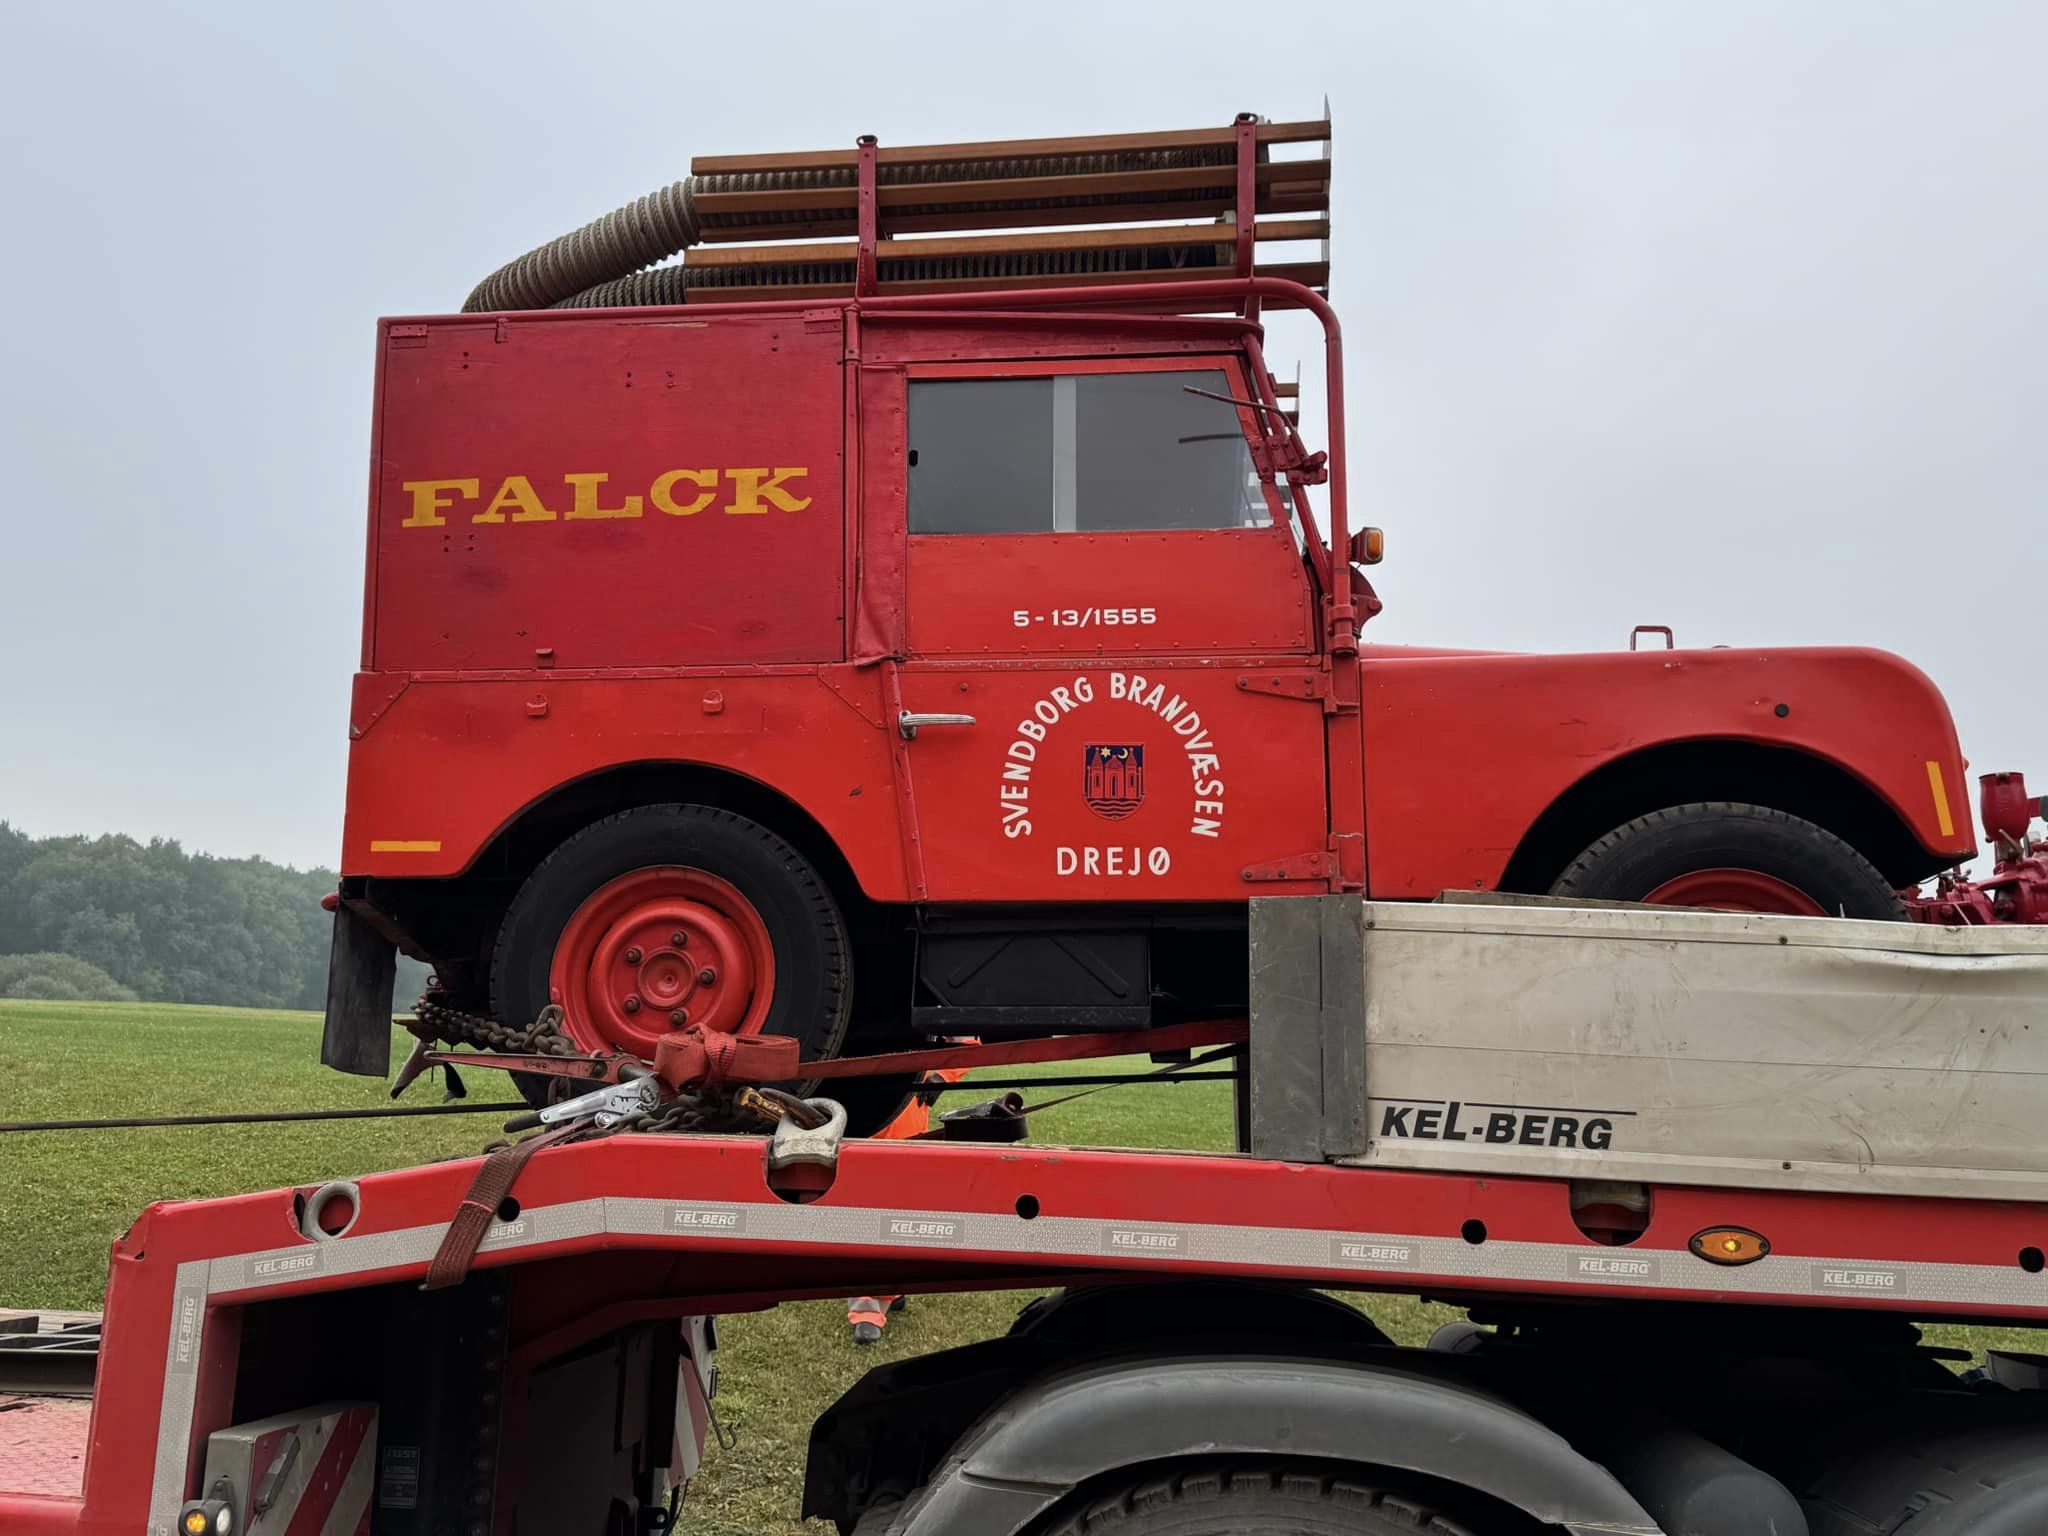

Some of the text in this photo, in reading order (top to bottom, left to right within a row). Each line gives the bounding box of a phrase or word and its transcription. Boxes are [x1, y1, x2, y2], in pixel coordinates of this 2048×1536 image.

[402, 467, 812, 528] FALCK
[1000, 672, 1224, 838] SVENDBORG BRANDVÆSEN
[1056, 846, 1171, 876] DREJØ
[1380, 1101, 1613, 1150] KEL-BERG
[674, 1211, 737, 1225] KEL-BERG
[487, 1223, 525, 1238] -BERG
[890, 1221, 954, 1236] KEL-BERG
[1112, 1231, 1178, 1247] KEL-BERG
[1341, 1244, 1409, 1260] KEL-BERG
[254, 1256, 315, 1275] KEL-BERG
[1579, 1257, 1649, 1274] KEL-BERG
[1824, 1270, 1896, 1286] KEL-BERG
[176, 1297, 195, 1363] KEL-BERG
